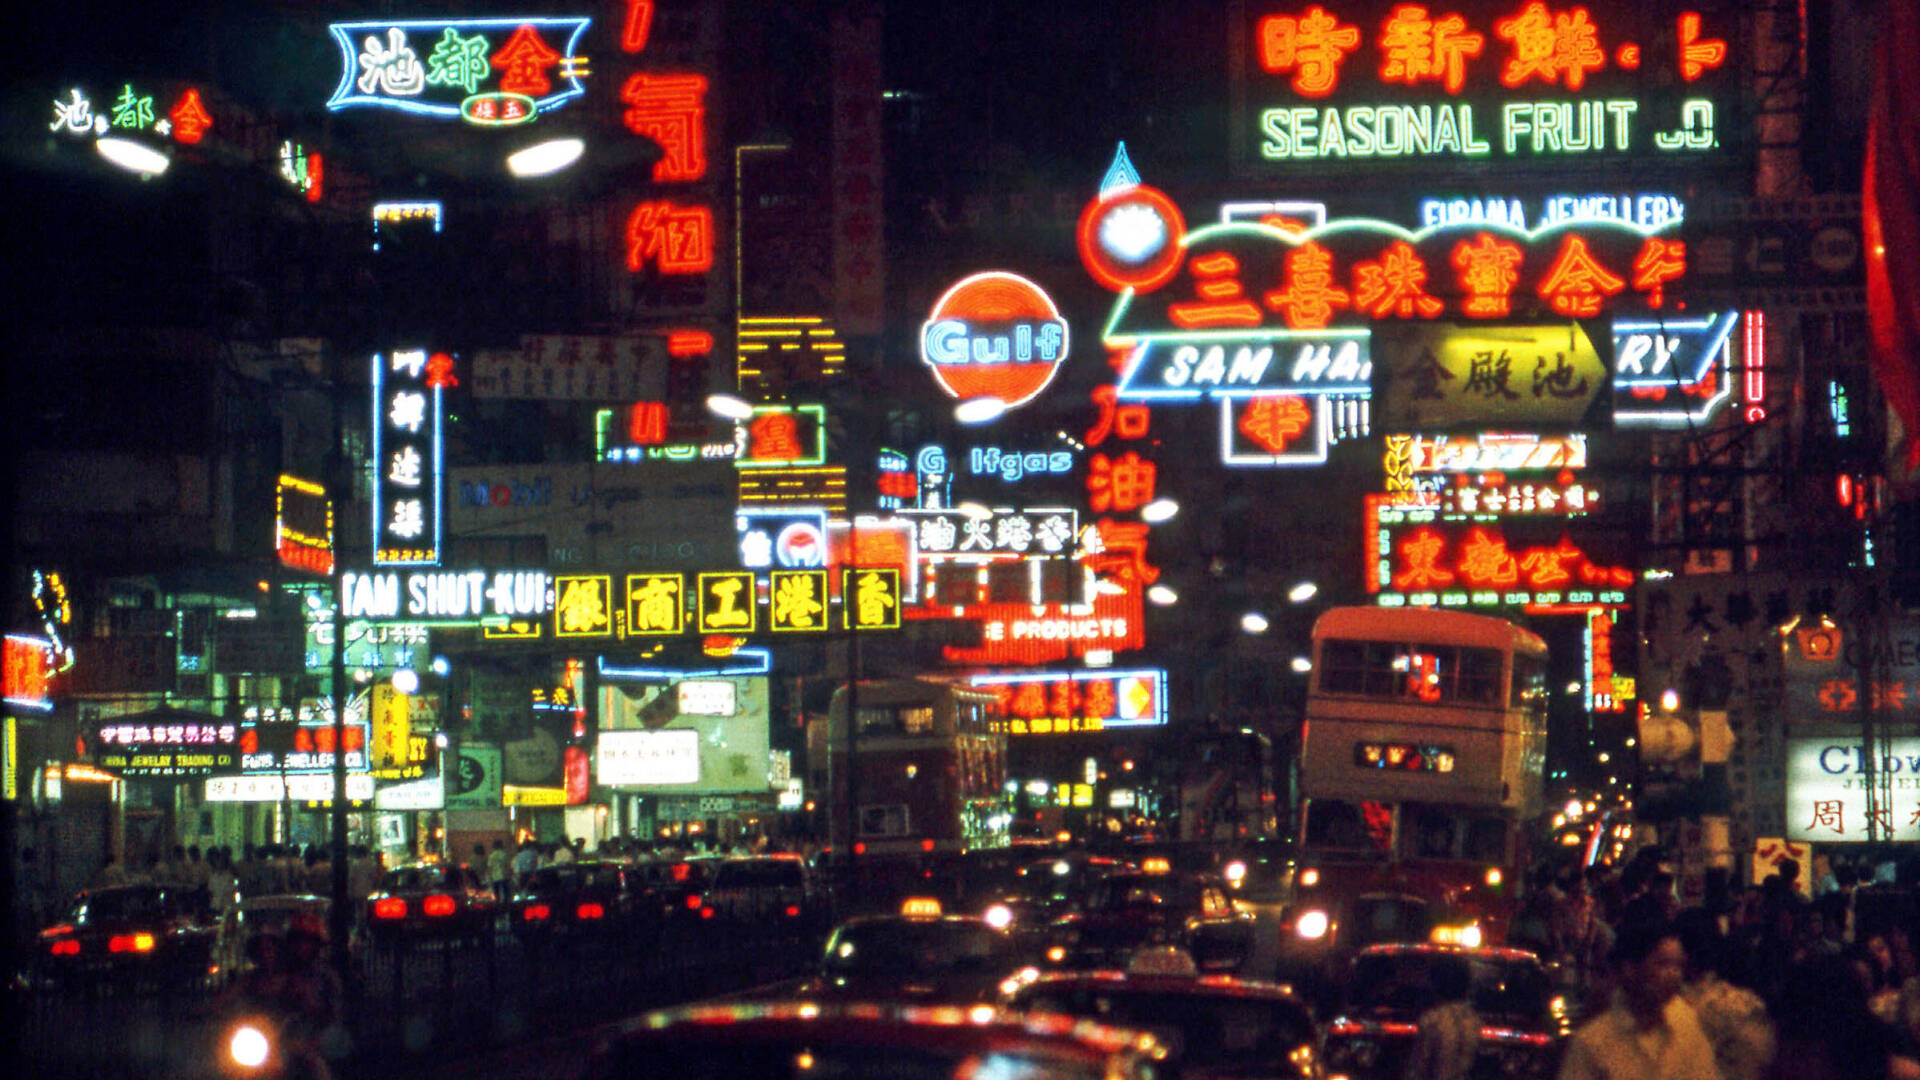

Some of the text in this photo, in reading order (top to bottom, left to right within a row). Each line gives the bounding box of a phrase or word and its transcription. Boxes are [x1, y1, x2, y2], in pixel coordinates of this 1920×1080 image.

[1258, 2, 1728, 97] 時新鮮
[1261, 104, 1489, 159] SEASONAL
[1504, 101, 1638, 154] FRUIT
[926, 320, 1063, 364] Gulf
[1164, 346, 1274, 386] SAM
[1292, 340, 1372, 383] HA
[918, 445, 1073, 481] Glfgas
[342, 573, 399, 617] TAM
[1013, 619, 1127, 640] PRODUCTS
[1805, 799, 1920, 835] 周大
